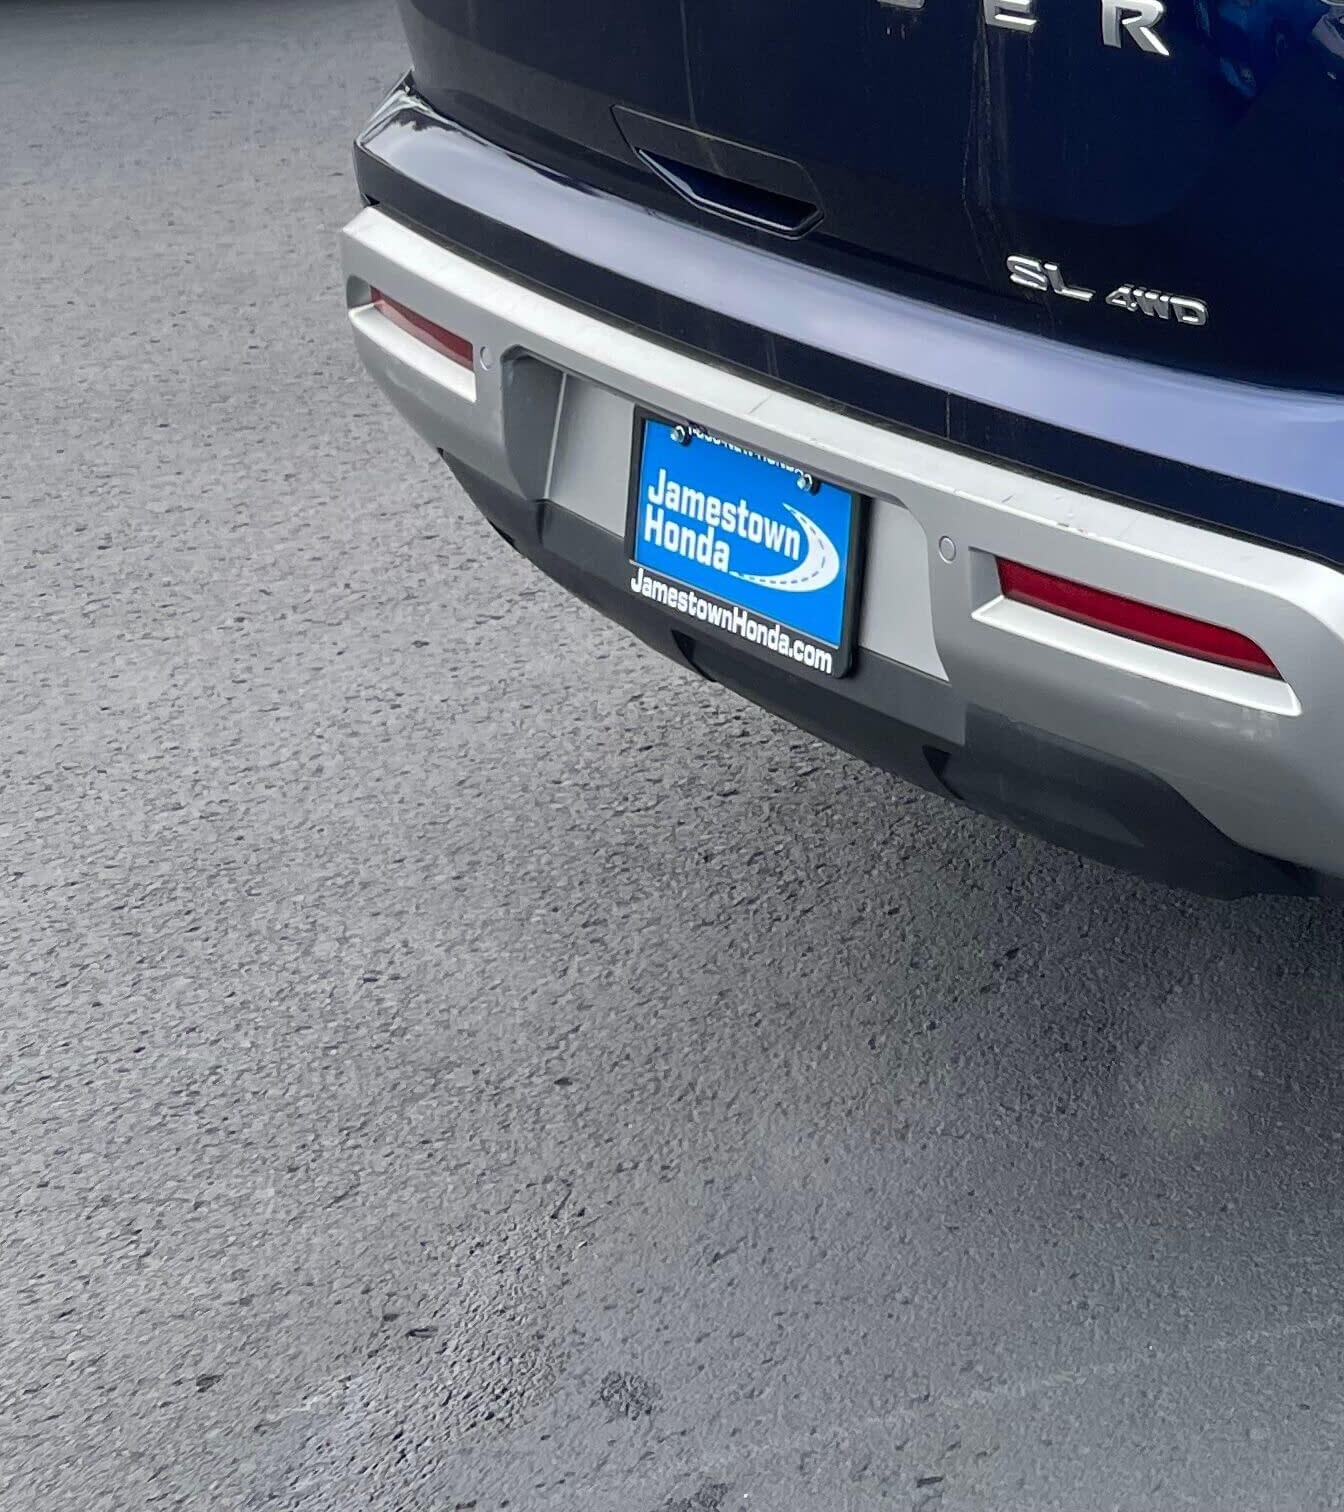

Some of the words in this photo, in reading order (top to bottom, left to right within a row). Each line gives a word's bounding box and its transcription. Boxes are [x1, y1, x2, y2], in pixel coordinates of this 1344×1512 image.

[1006, 255, 1096, 302] SL
[1104, 284, 1208, 326] 4WD
[643, 503, 731, 574] Honda
[647, 468, 801, 561] Jamestown
[630, 567, 833, 674] JamestownHonda.com
